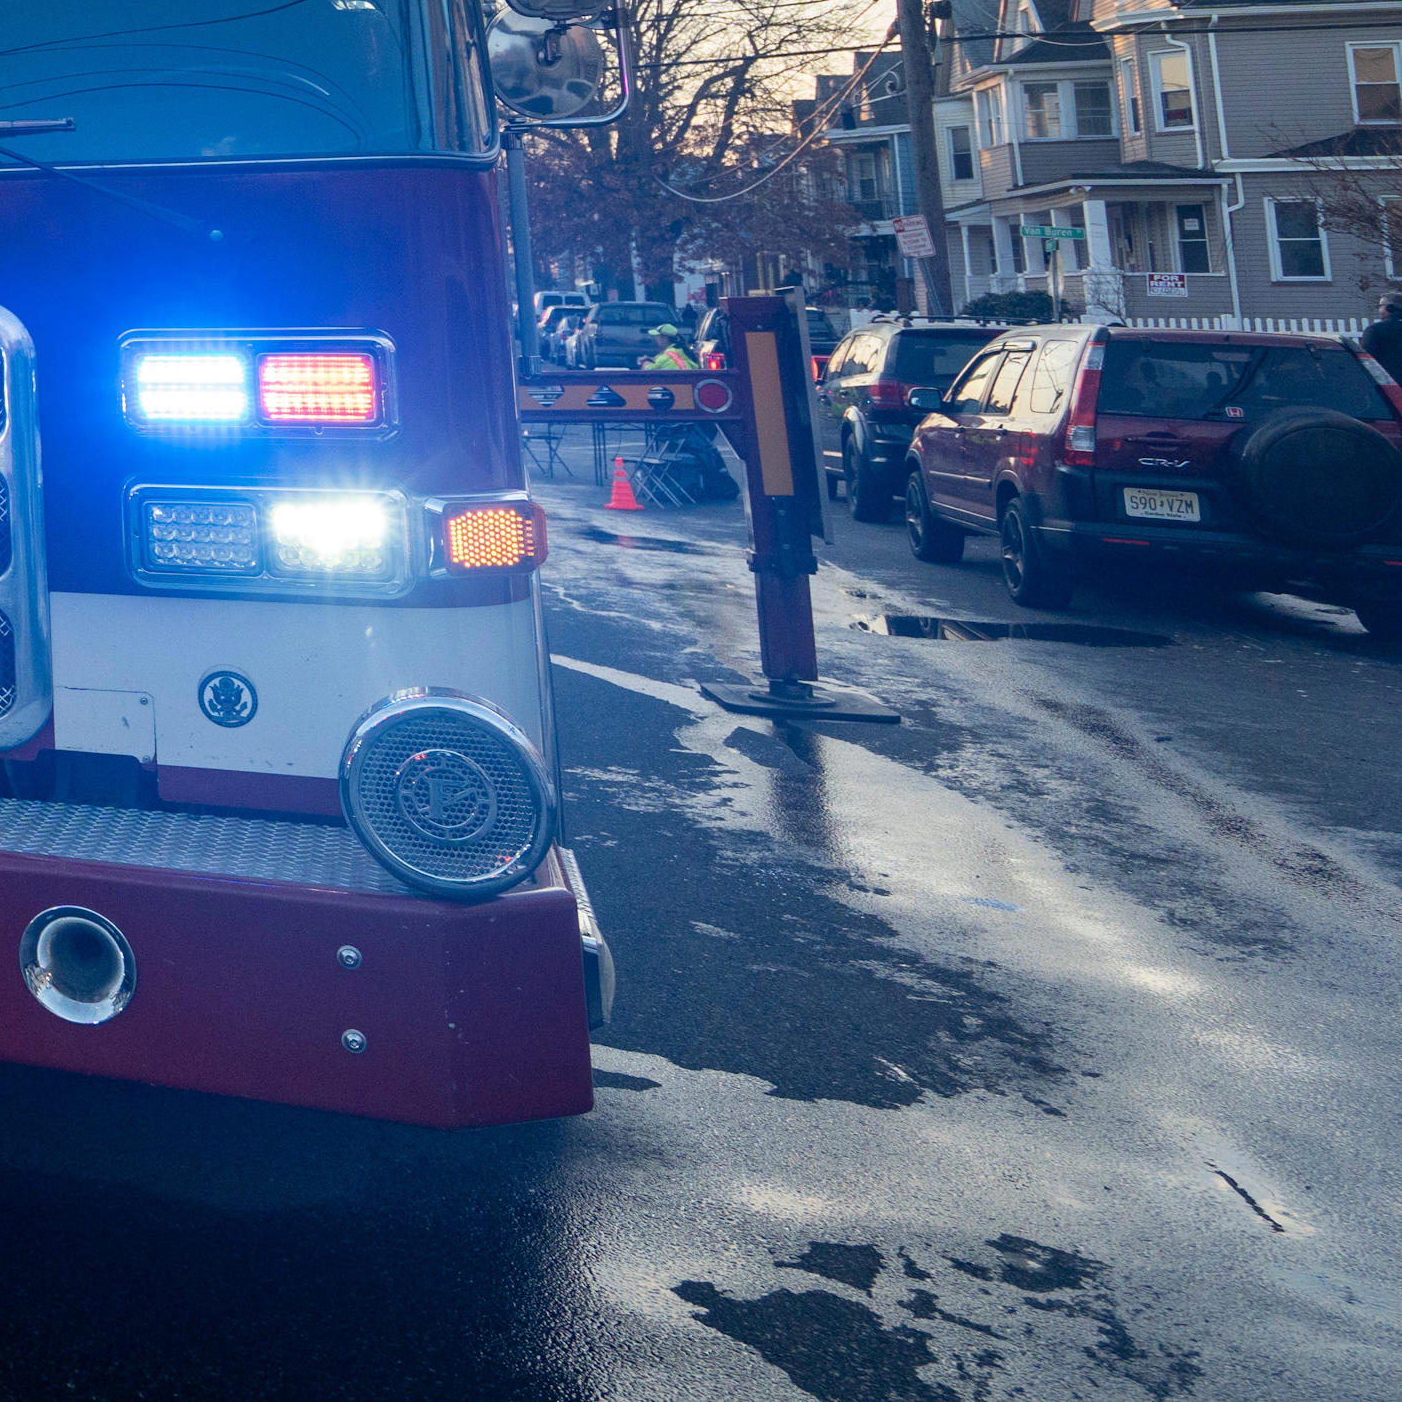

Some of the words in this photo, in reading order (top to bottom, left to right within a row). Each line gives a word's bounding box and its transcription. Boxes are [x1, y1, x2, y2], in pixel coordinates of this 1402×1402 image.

[1024, 227, 1041, 235] Van
[1044, 227, 1073, 237] Buren
[1138, 457, 1191, 468] CR-V
[1166, 498, 1195, 514] VZM
